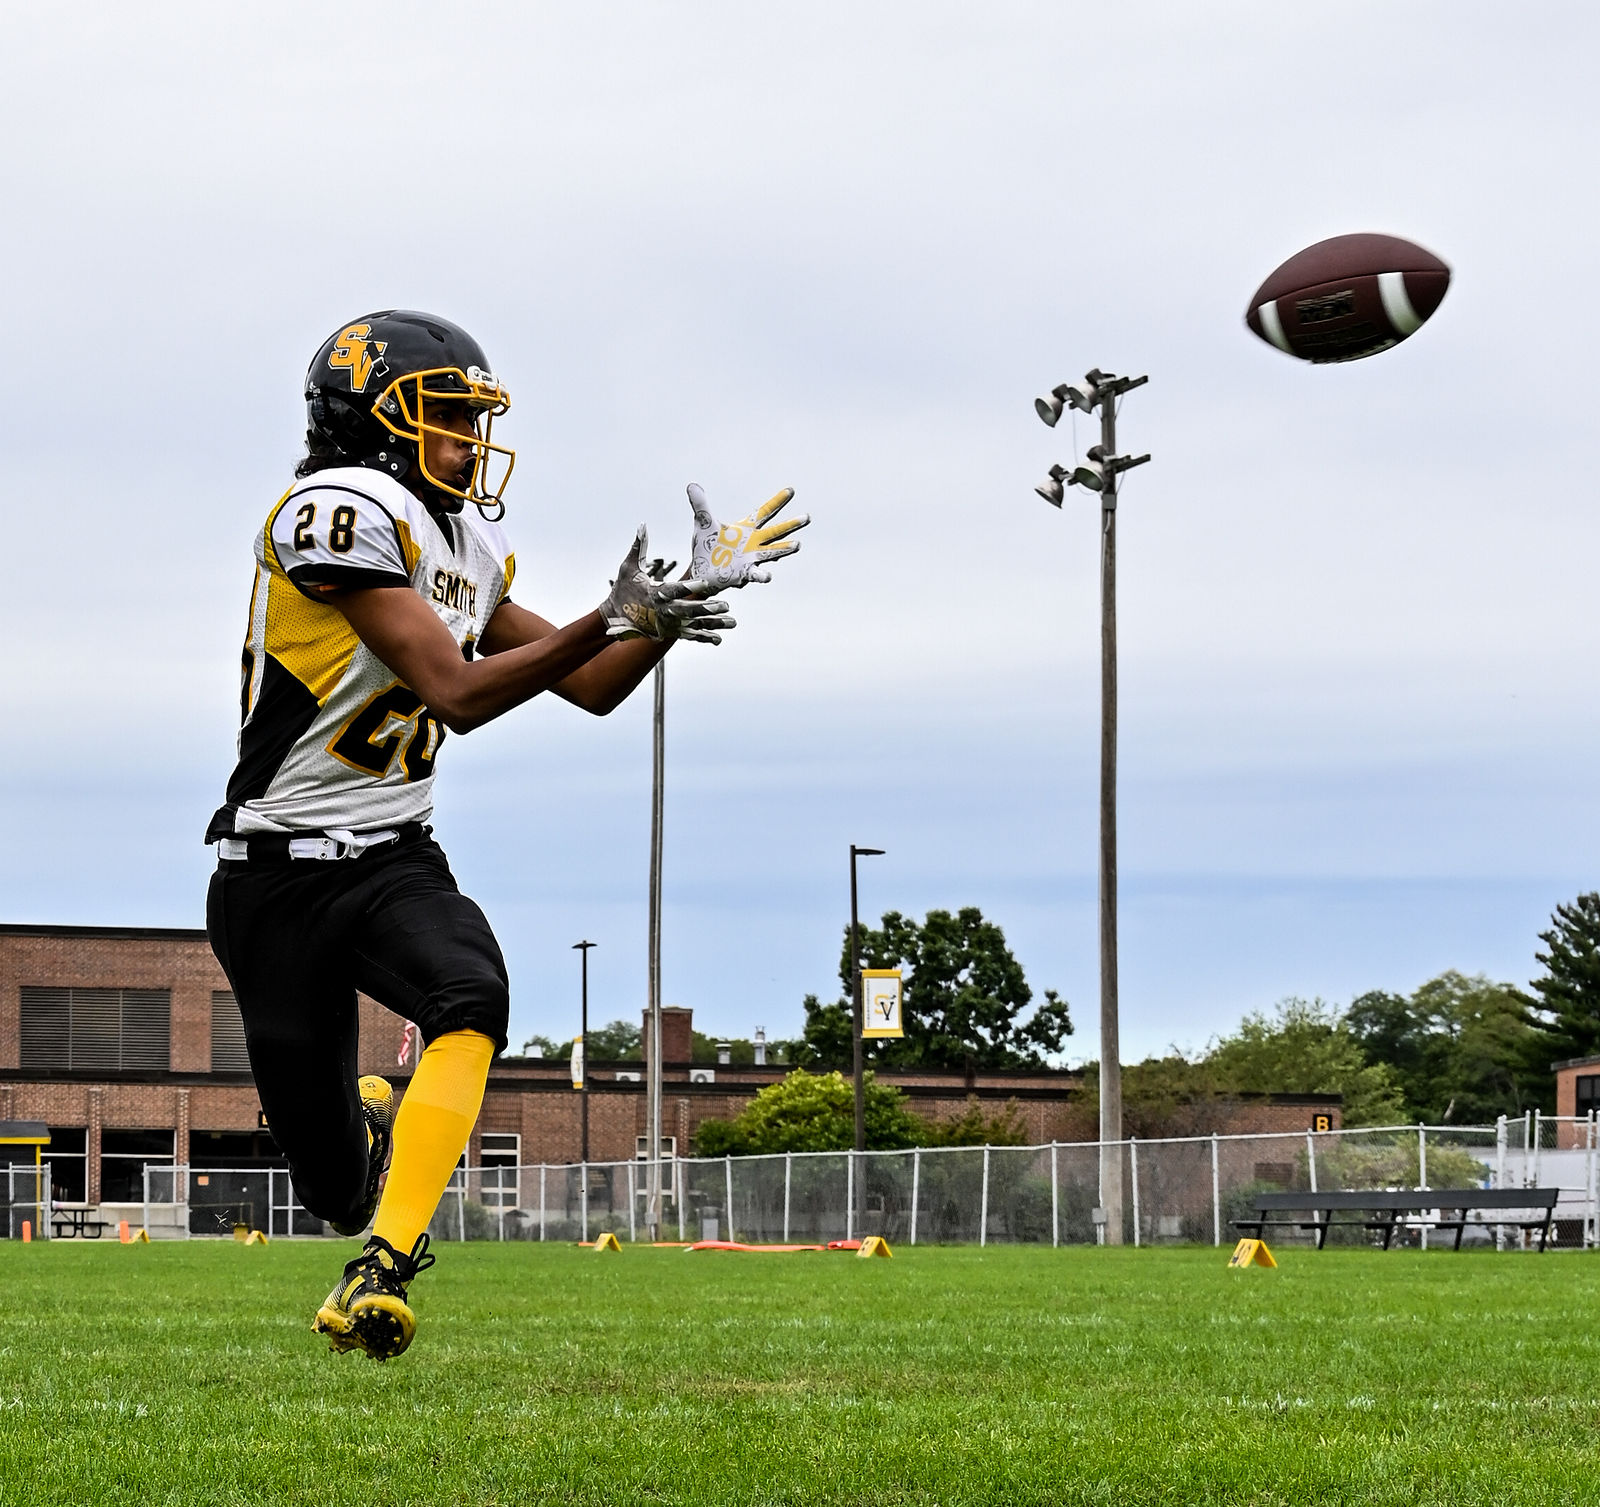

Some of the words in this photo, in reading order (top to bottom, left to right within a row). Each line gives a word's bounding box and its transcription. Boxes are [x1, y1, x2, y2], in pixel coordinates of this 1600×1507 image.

[328, 324, 389, 393] SV
[294, 502, 358, 555] 28
[431, 567, 477, 619] SMITH
[1316, 1116, 1329, 1132] B
